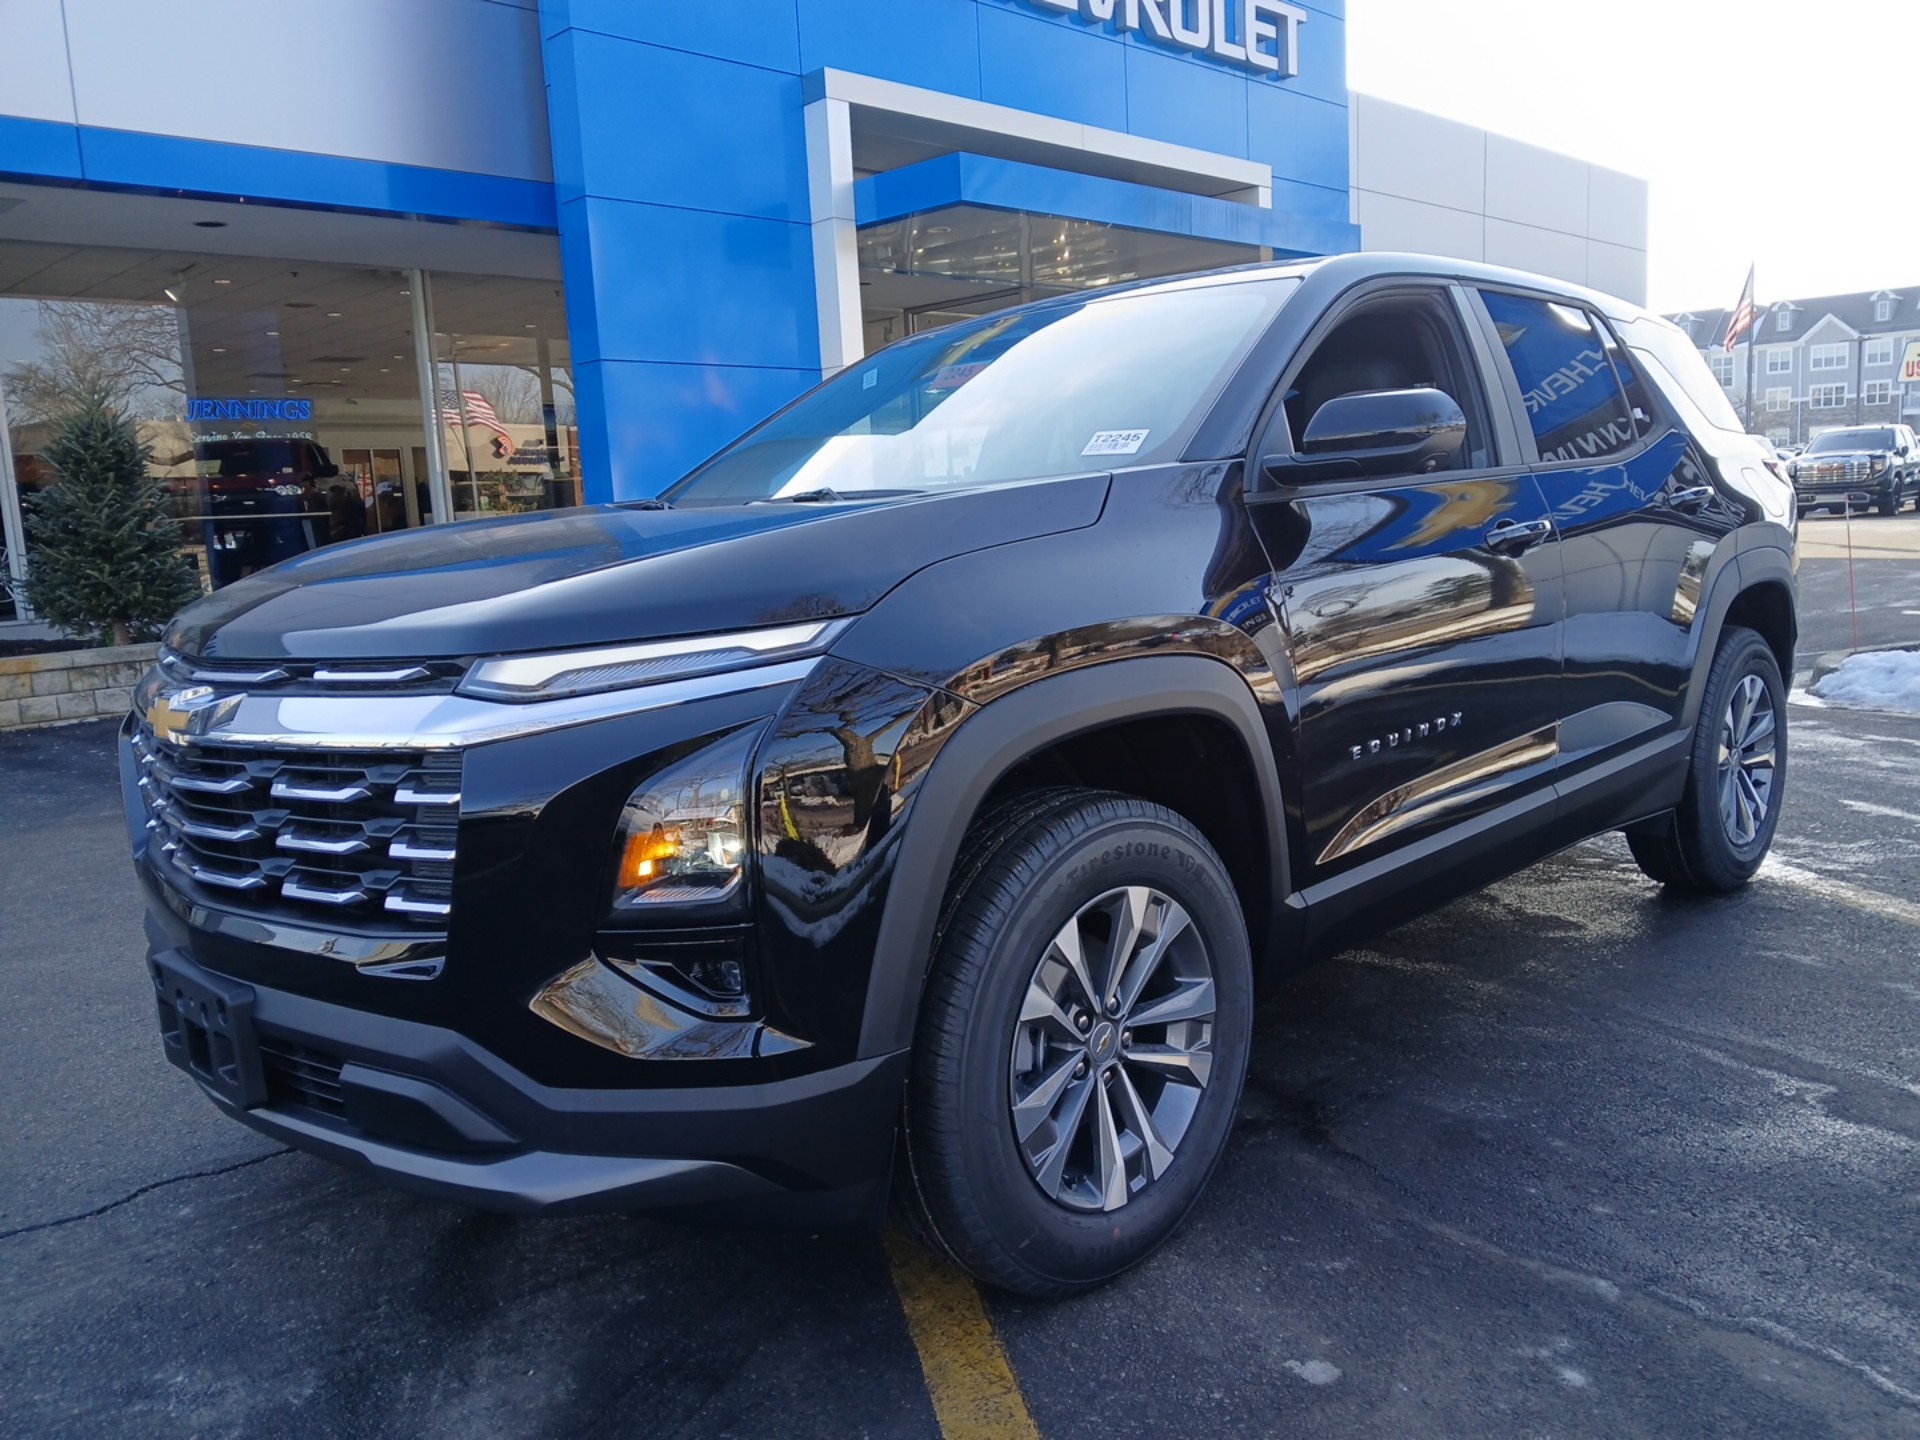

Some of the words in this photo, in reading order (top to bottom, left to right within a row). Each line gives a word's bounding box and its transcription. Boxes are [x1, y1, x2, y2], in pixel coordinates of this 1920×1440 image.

[185, 399, 311, 421] JENNINGS
[1094, 432, 1144, 443] T2245
[1349, 711, 1462, 760] EQUINOX
[1066, 840, 1171, 885] Firestone
